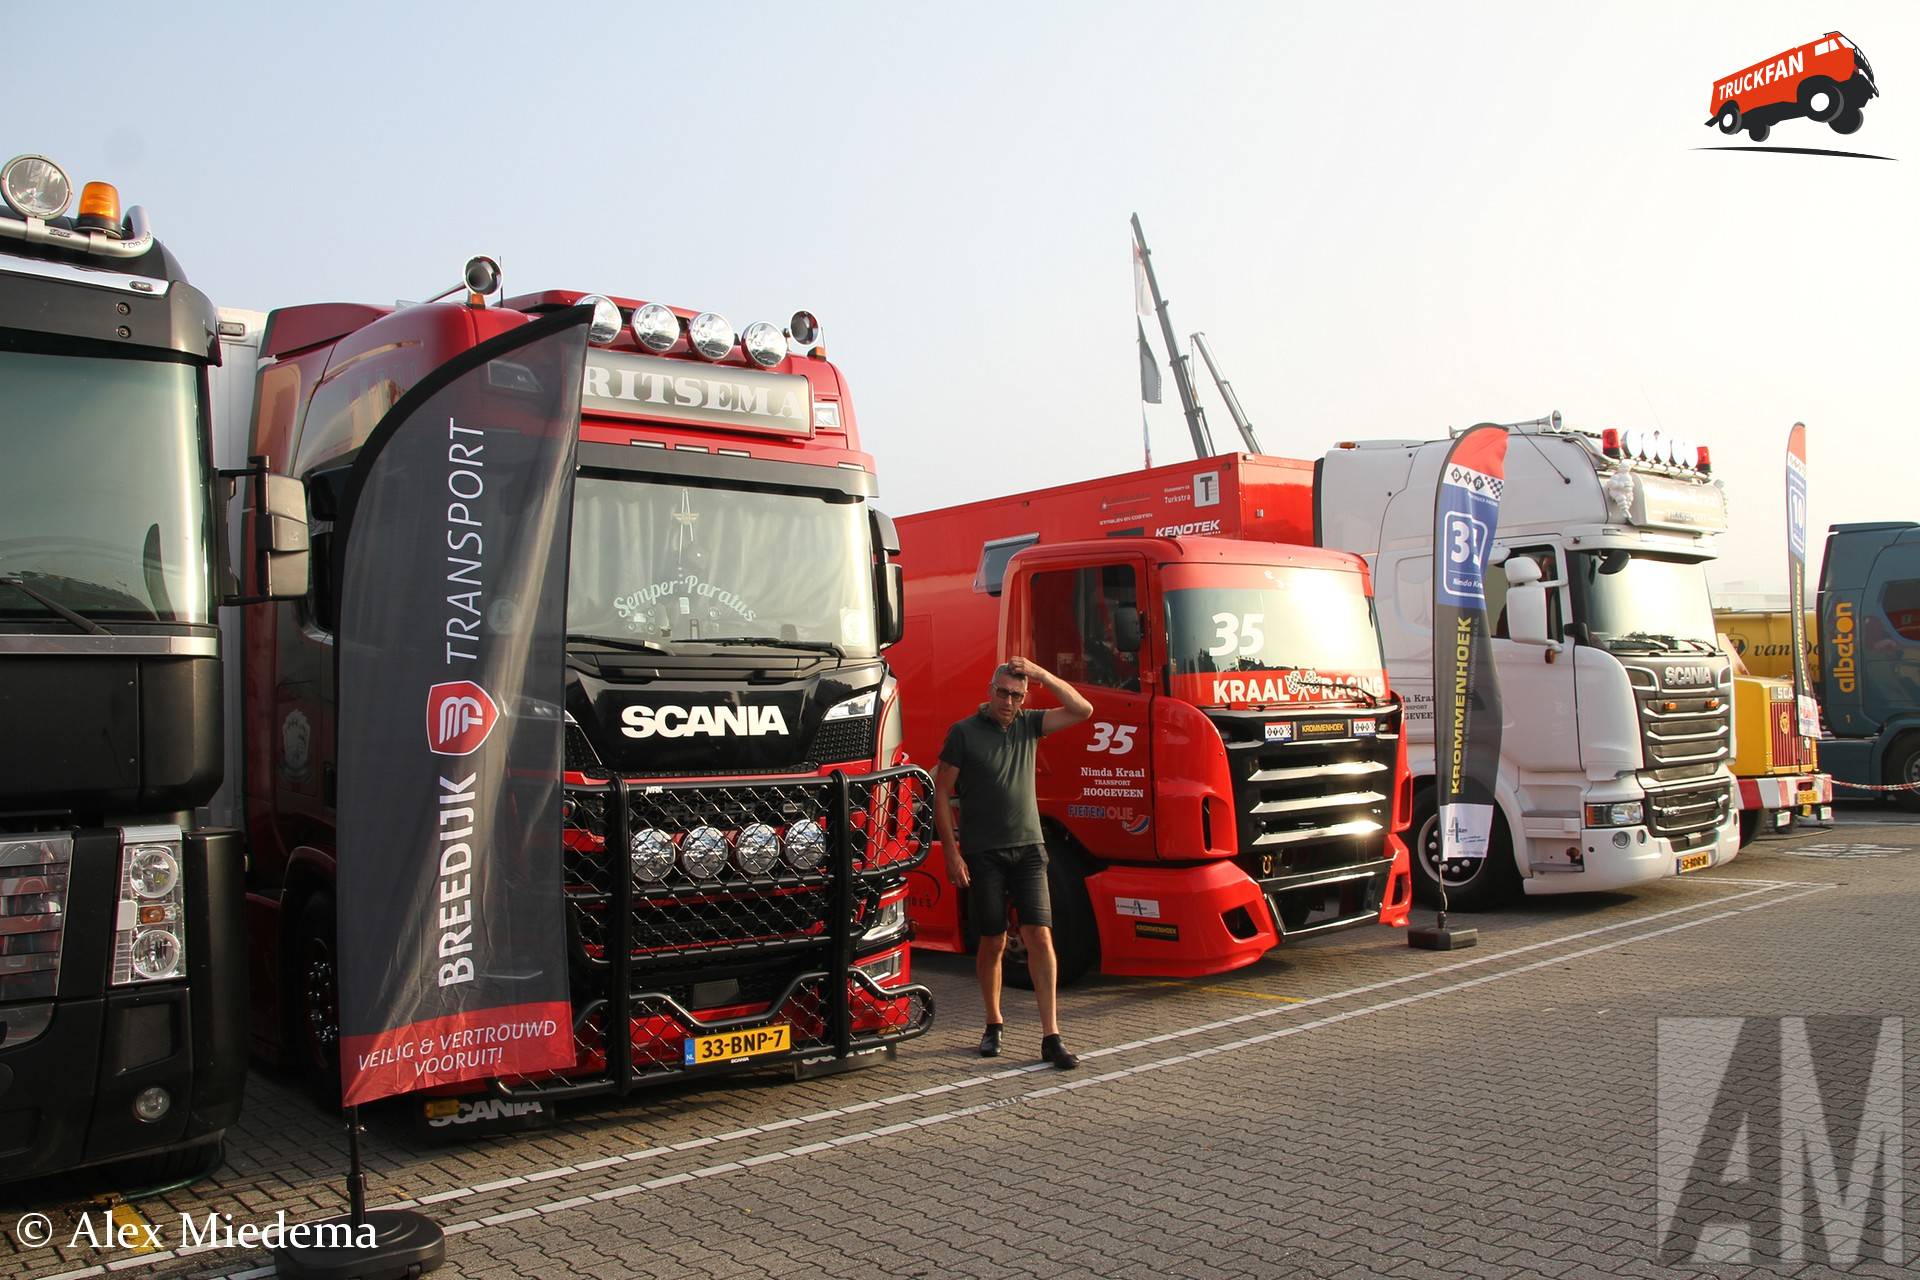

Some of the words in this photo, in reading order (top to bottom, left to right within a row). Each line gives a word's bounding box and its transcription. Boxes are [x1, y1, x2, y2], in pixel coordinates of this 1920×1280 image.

[583, 366, 804, 419] RITSEMA
[447, 417, 484, 664] TRANSPORT
[1155, 519, 1220, 537] KENOTEK
[613, 580, 678, 618] Semper
[684, 574, 757, 622] Paratus
[1209, 612, 1264, 656] 35
[1832, 601, 1855, 693] albeton
[1754, 644, 1791, 657] van
[1213, 679, 1290, 703] KRAAL
[1321, 676, 1385, 699] RACING
[1665, 666, 1712, 686] SCANIA
[1451, 617, 1472, 794] KROMMENHOEK
[1777, 687, 1794, 699] SCA
[621, 705, 790, 738] SCANIA
[1301, 723, 1345, 733] KROMMENHOEK
[1086, 722, 1138, 755] 35
[1080, 767, 1112, 777] Nimda
[1116, 768, 1145, 778] Kraal
[1083, 787, 1144, 798] HOOGEVEEN
[1107, 806, 1134, 820] OLIE
[438, 772, 477, 987] BREEDIJK
[358, 1041, 414, 1072] VEILIG
[419, 1038, 435, 1055] &
[439, 1020, 557, 1050] VERTROUWD
[702, 1029, 784, 1059] 33-BNP-7
[415, 1046, 503, 1077] VOORUIT!
